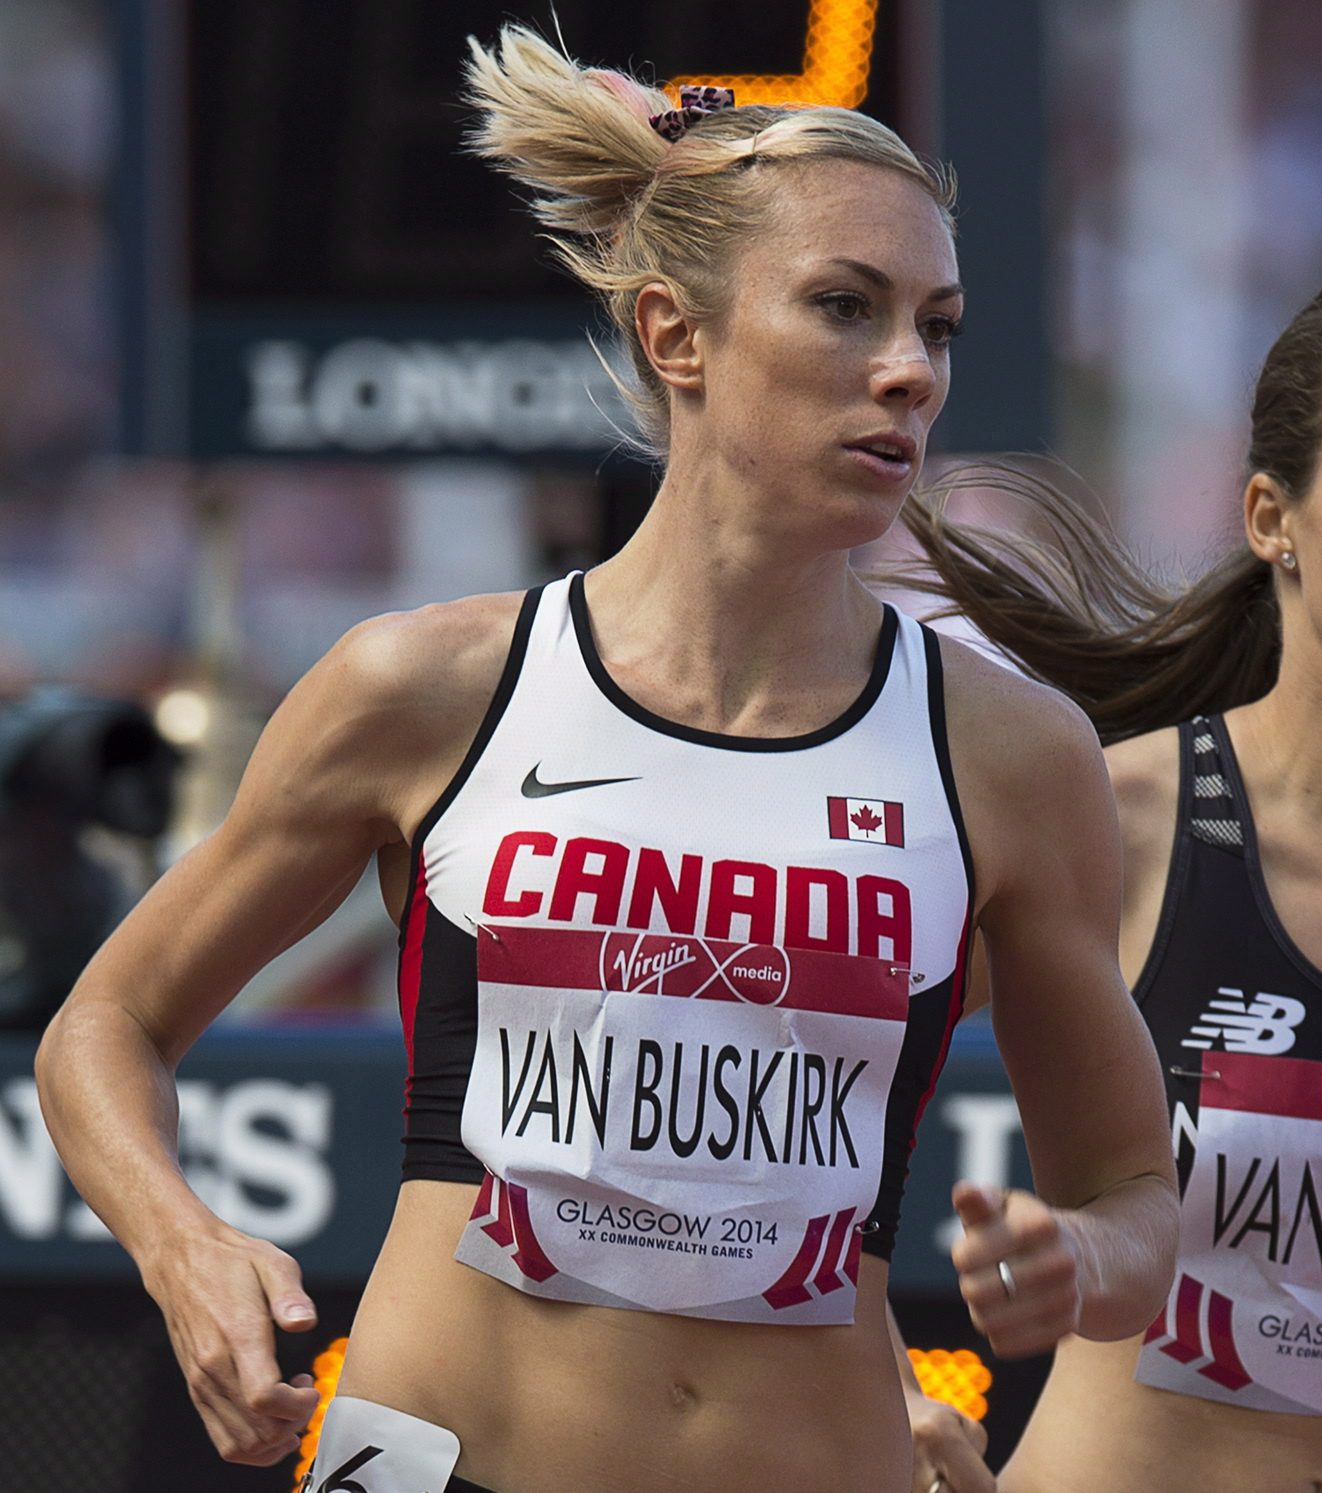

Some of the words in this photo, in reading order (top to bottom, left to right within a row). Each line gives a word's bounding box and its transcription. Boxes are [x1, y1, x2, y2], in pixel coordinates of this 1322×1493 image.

[242, 338, 632, 452] LONGI
[481, 830, 912, 962] CANADA
[613, 934, 697, 995] Virgin
[732, 966, 782, 982] media
[498, 1027, 614, 1150] VAN
[629, 1039, 869, 1169] BUSKIRK
[556, 1198, 712, 1239] GLASGOW
[720, 1217, 779, 1246] 2014
[578, 1228, 596, 1241] XX
[600, 1231, 707, 1255] COMMONWEALTH
[711, 1246, 754, 1260] GAMES
